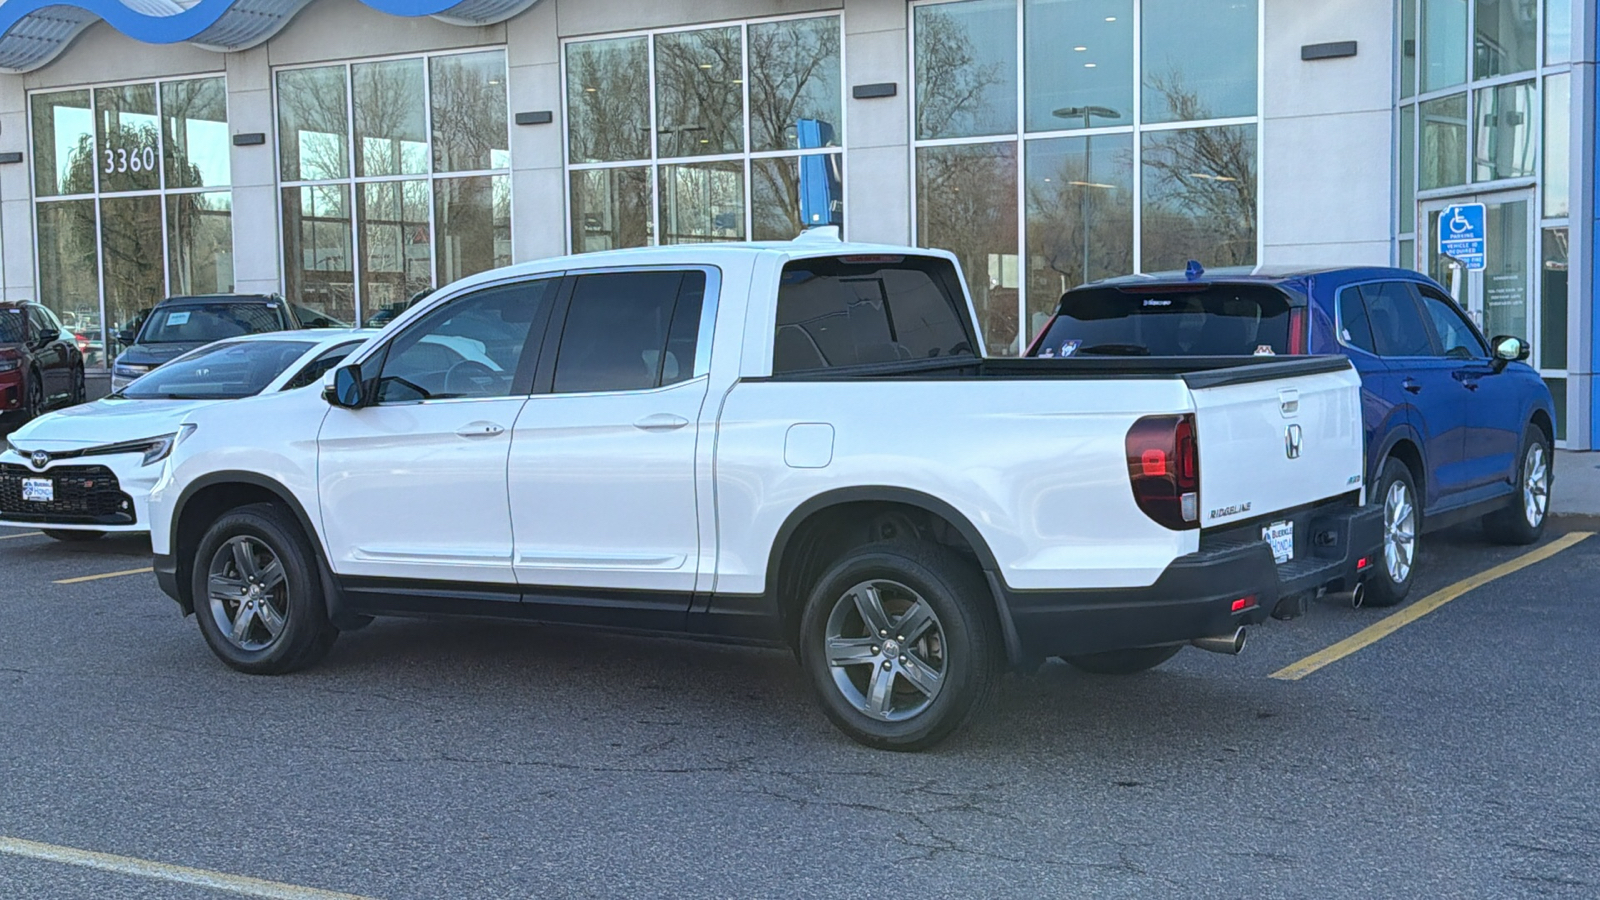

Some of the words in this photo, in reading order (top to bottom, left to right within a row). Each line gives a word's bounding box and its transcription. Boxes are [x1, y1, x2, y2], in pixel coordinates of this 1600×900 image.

[104, 146, 155, 174] 3360
[1209, 501, 1252, 519] RIDGELINE
[1271, 527, 1293, 539] BUERKLE
[1271, 538, 1293, 553] HONDA
